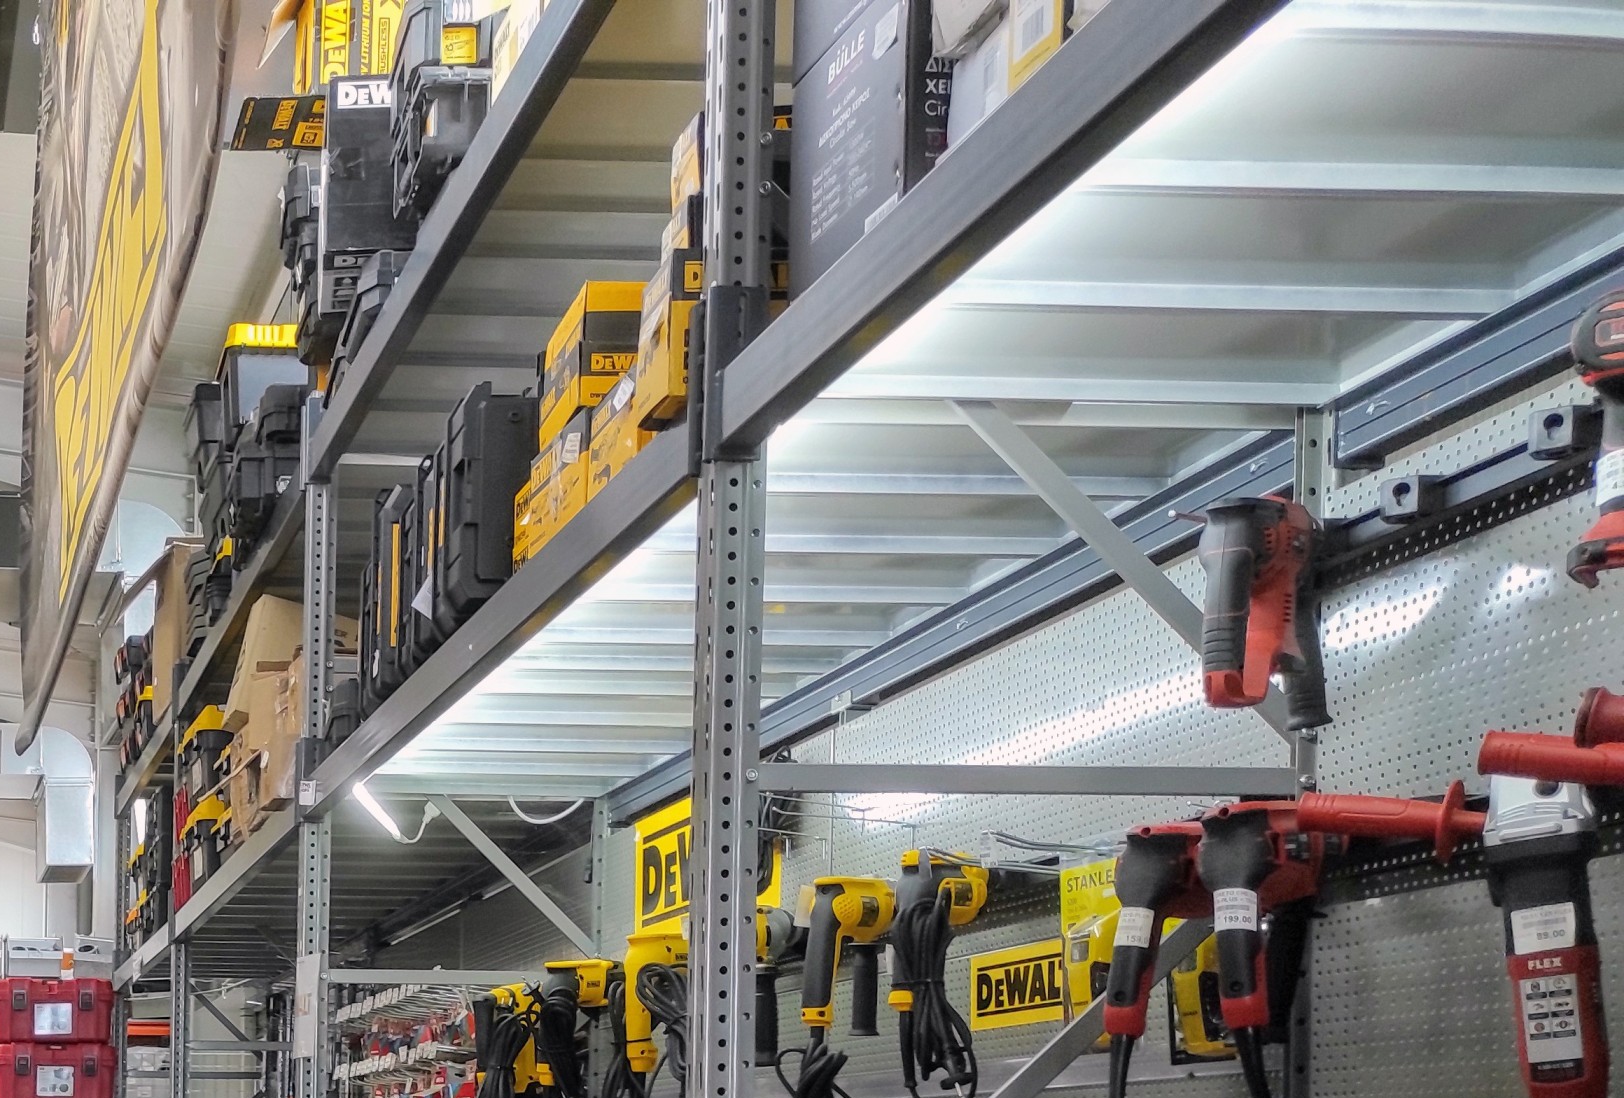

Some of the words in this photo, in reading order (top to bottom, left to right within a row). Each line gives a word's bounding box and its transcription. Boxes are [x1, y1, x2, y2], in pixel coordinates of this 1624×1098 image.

[828, 29, 865, 85] BÜLLE
[1067, 868, 1115, 893] STANLE
[1528, 957, 1563, 970] FLEX
[977, 958, 1063, 1011] DEWAL
